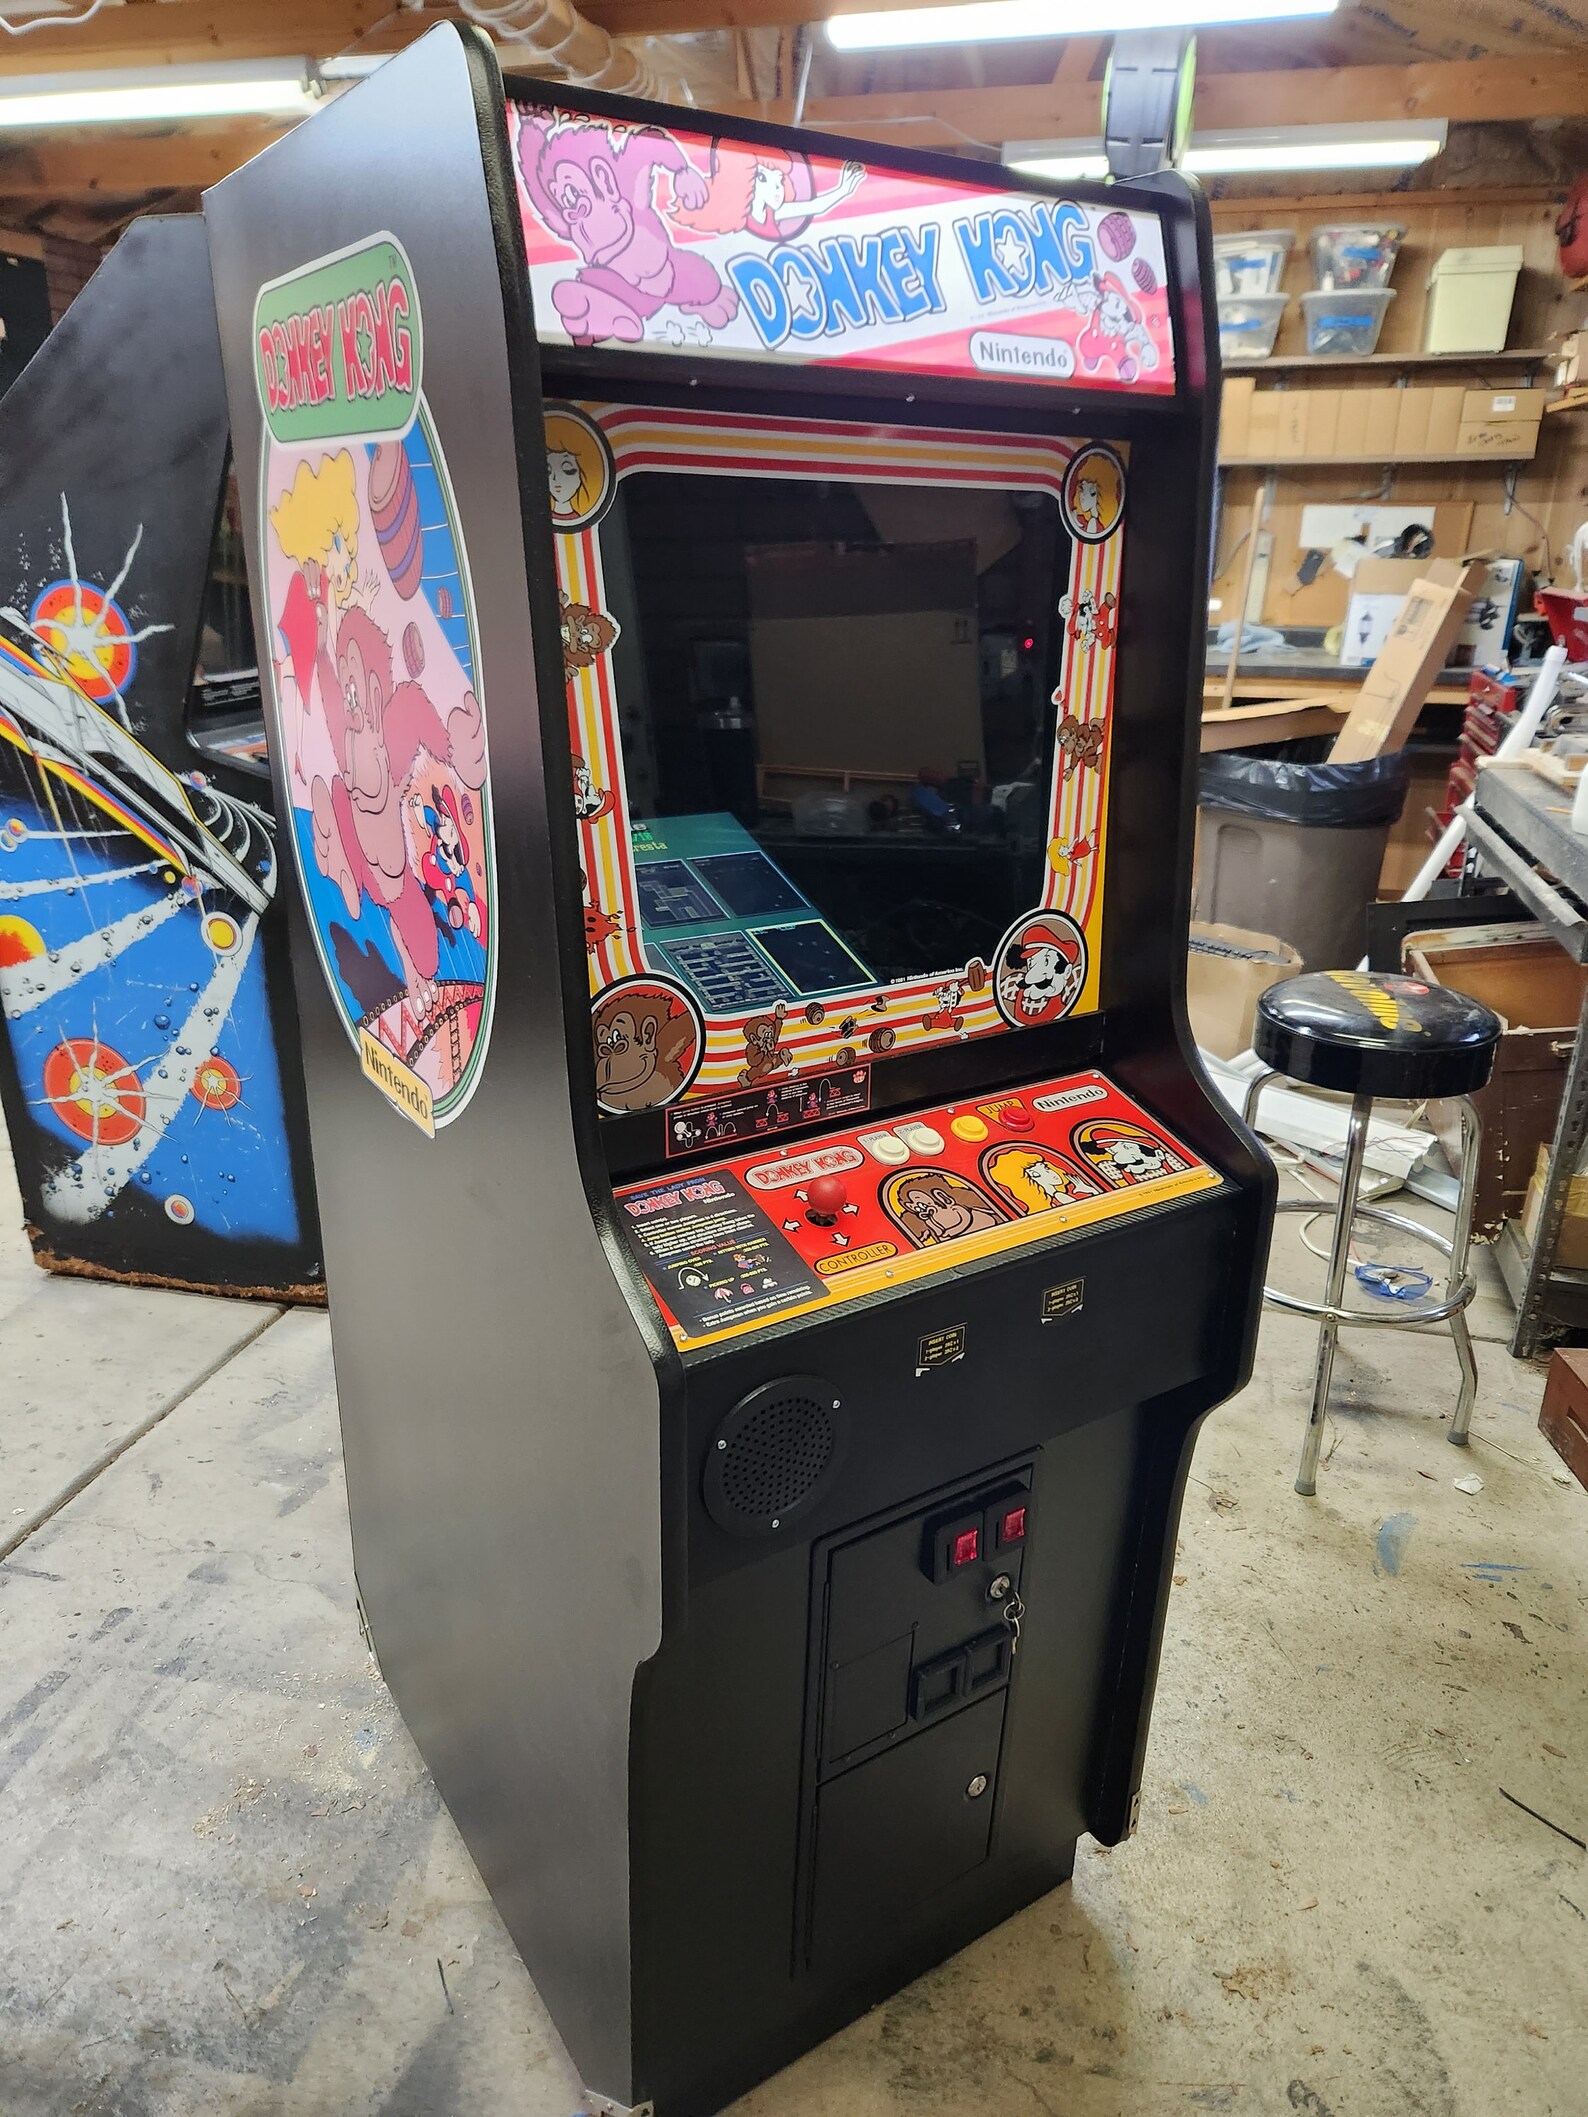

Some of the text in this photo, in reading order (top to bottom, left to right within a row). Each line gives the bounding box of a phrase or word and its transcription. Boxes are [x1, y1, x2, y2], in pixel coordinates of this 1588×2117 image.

[726, 201, 1096, 350] DONKEY KONG
[259, 275, 413, 415] DONKEY KONG
[980, 341, 1068, 368] Nintendo
[363, 1040, 429, 1120] Nintendo
[1037, 1089, 1104, 1110] Nintendo
[753, 1150, 857, 1185] DONKEY KONG
[624, 1180, 725, 1217] DONKEY KONG
[702, 1192, 736, 1205] Nintendo
[690, 1239, 737, 1256] SCORING VALUE
[819, 1244, 892, 1272] CONTROLLER
